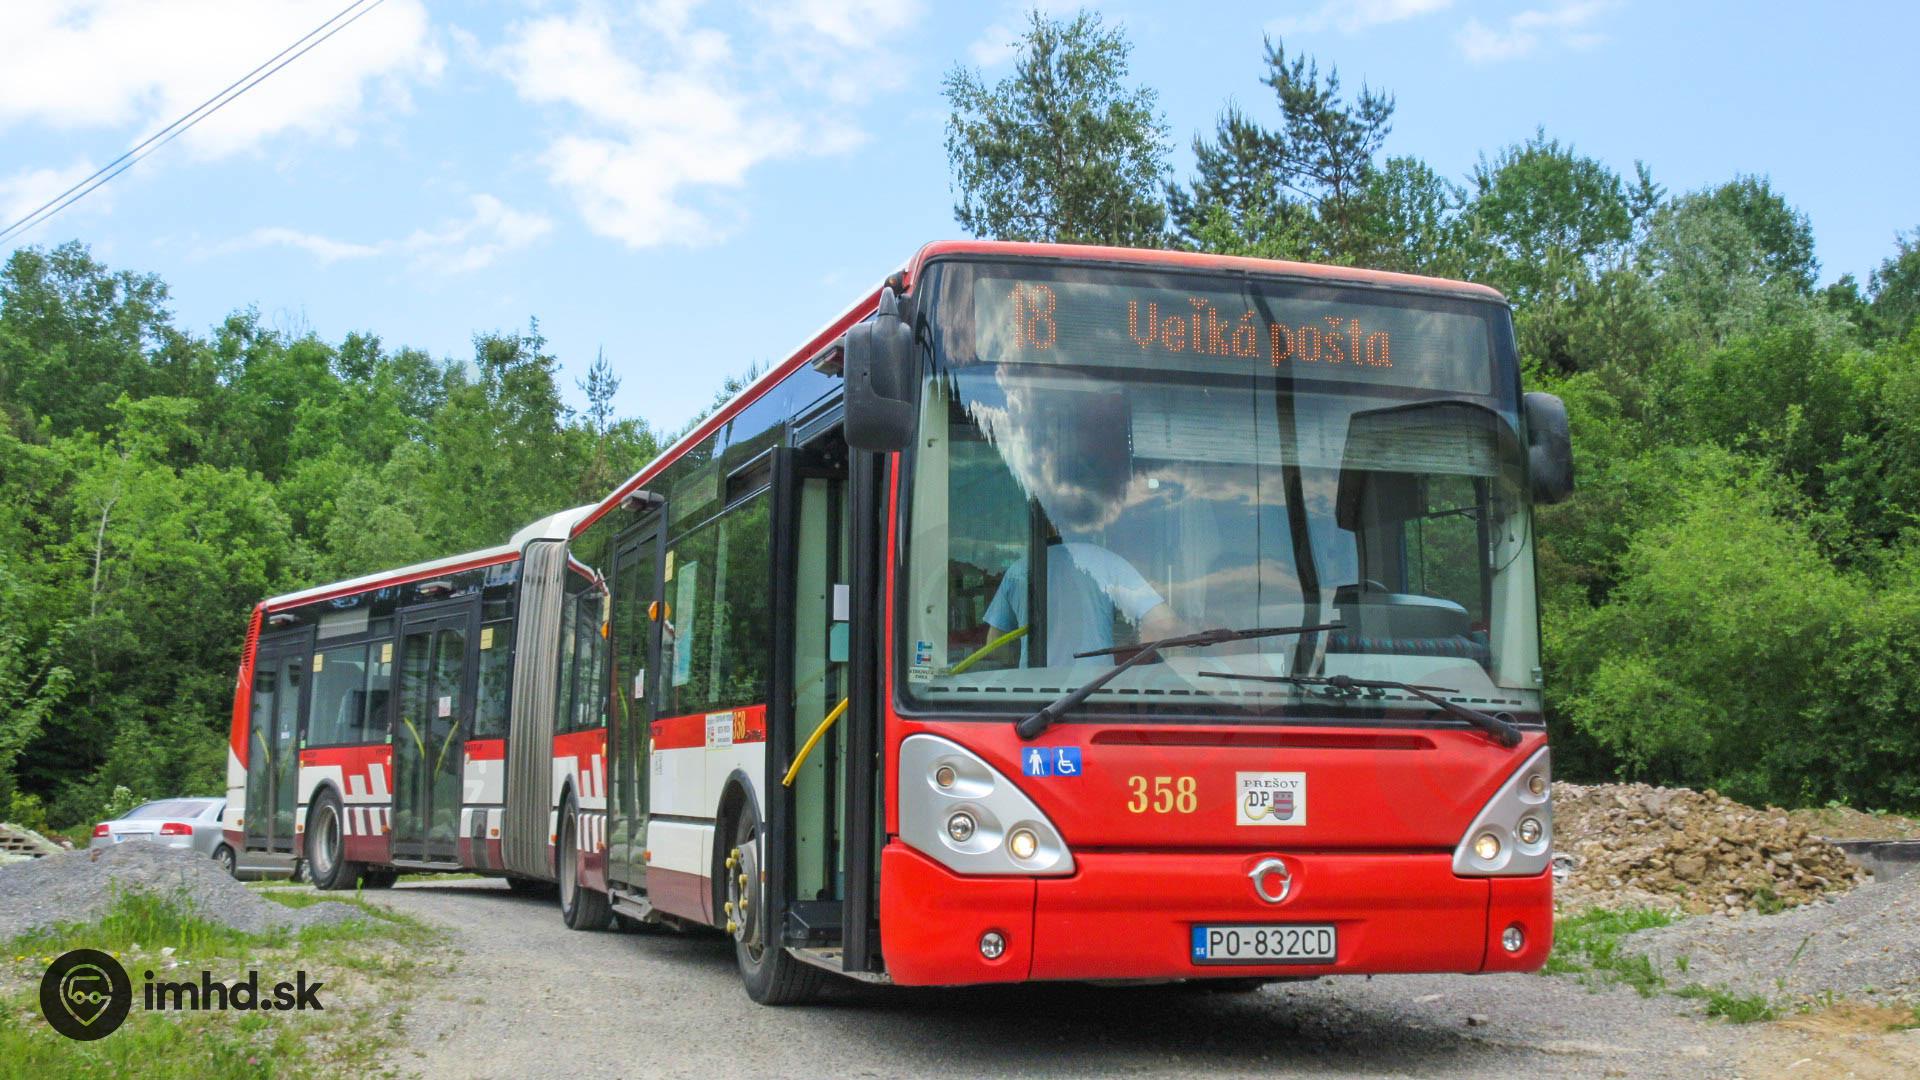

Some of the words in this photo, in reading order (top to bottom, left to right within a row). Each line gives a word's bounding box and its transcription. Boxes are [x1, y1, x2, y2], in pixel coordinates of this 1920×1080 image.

[1008, 282, 1056, 351] 18
[1269, 313, 1393, 368] pošta
[1127, 775, 1198, 814] 358
[1243, 777, 1299, 788] PREŠOV
[1248, 790, 1270, 807] DP
[1210, 929, 1332, 956] PO-832CD
